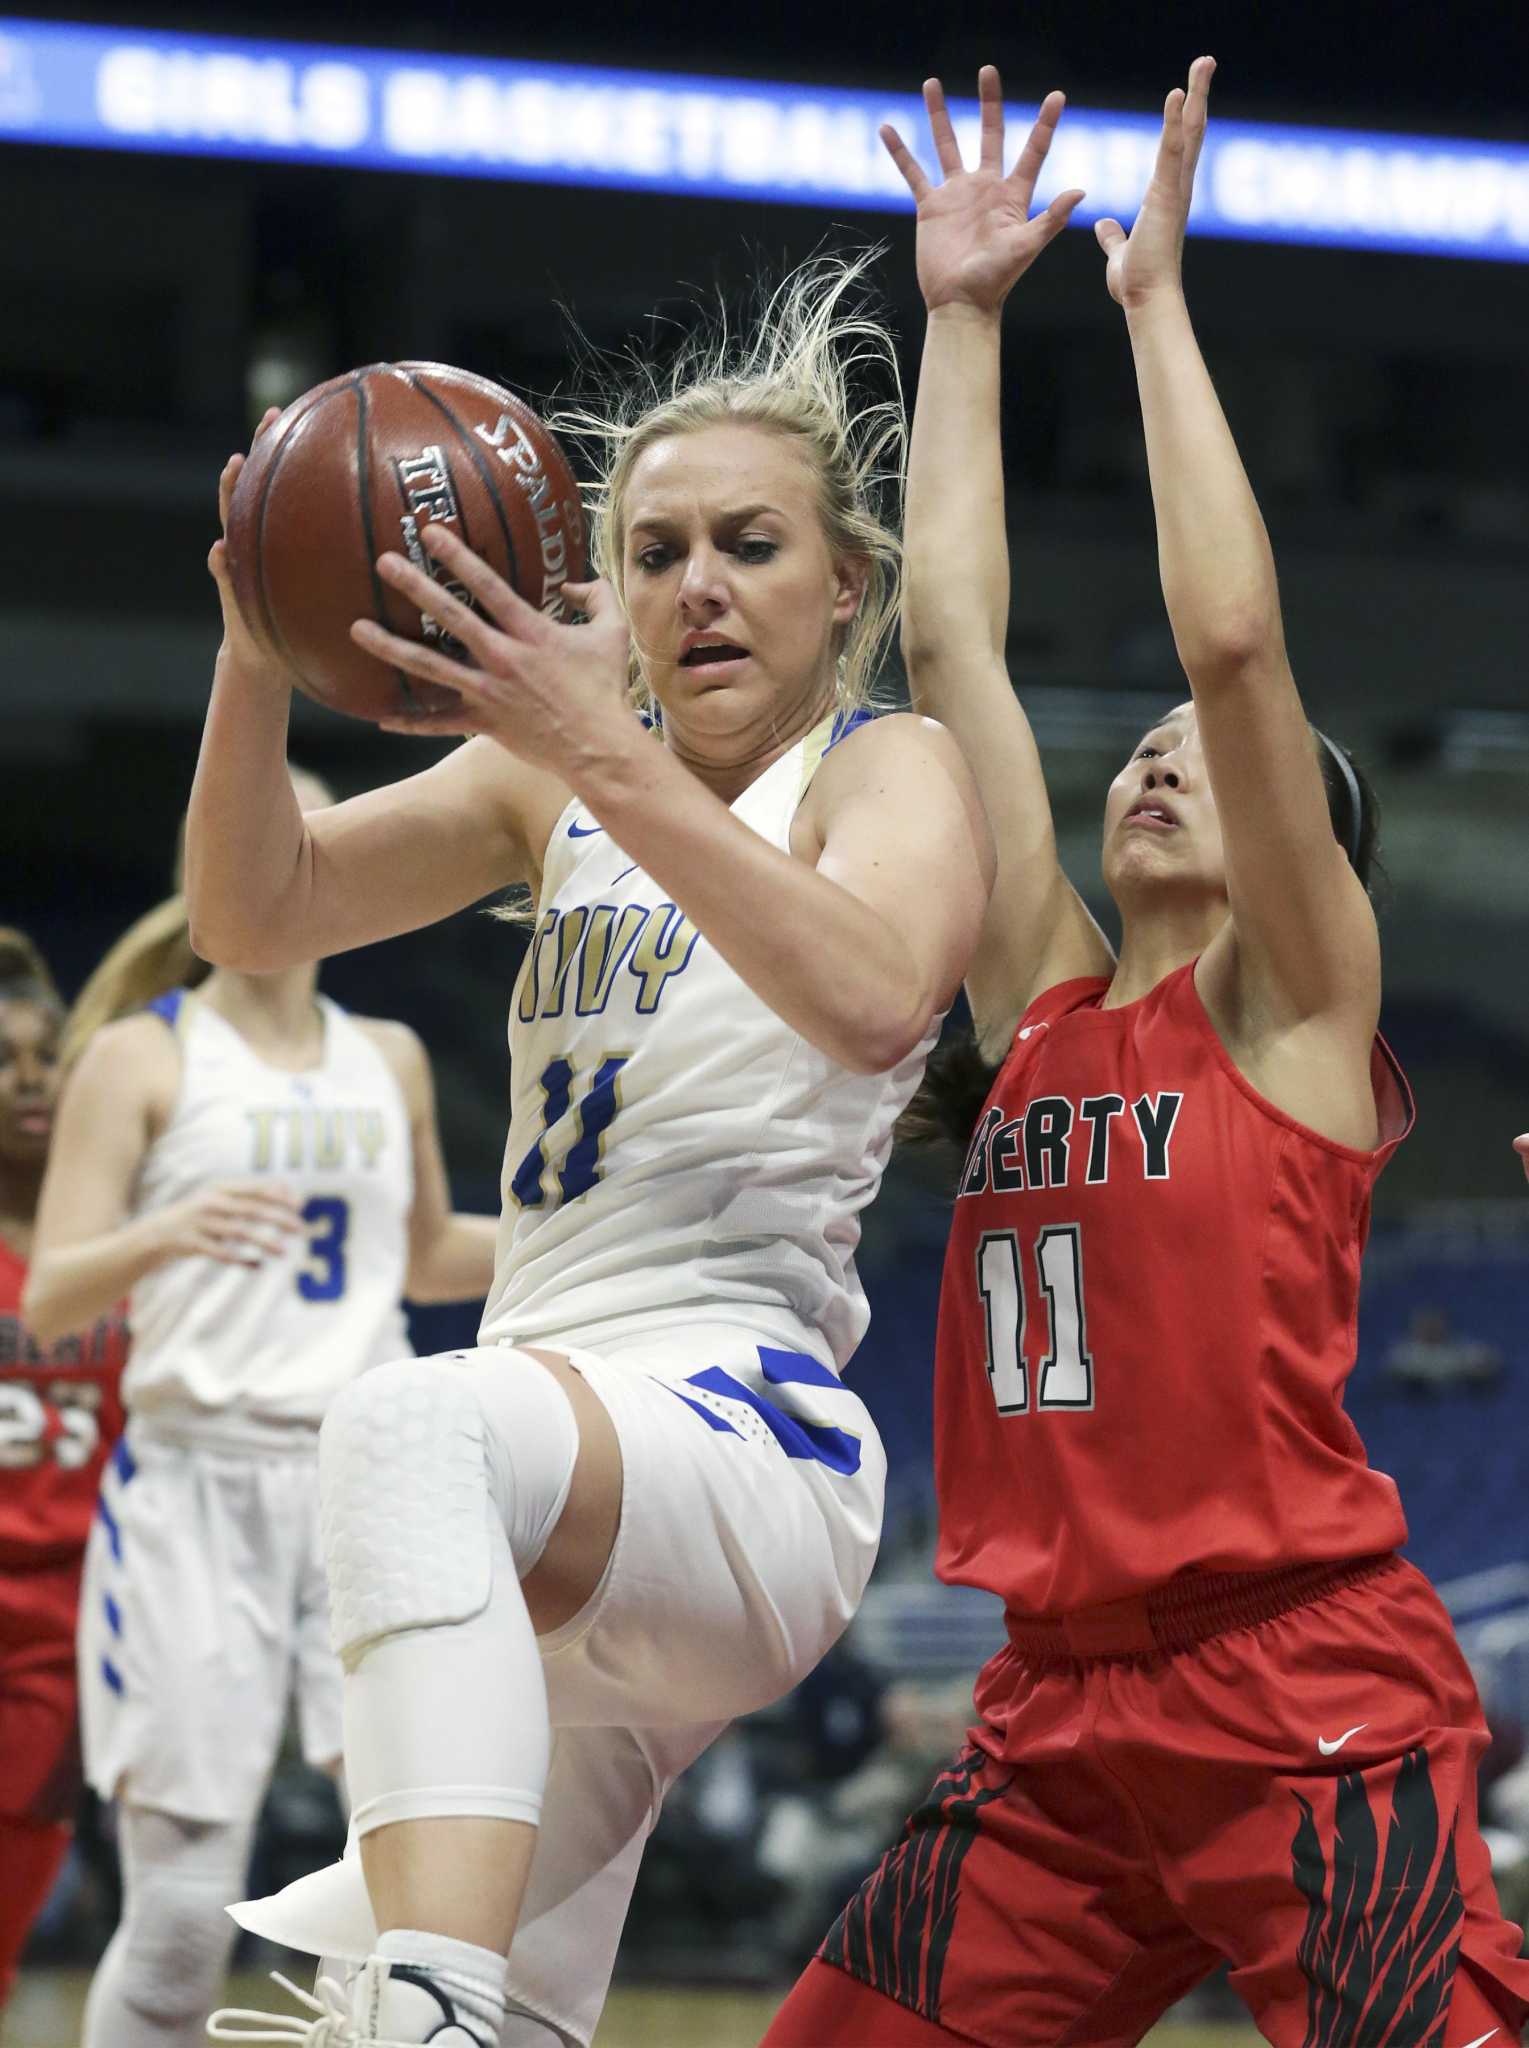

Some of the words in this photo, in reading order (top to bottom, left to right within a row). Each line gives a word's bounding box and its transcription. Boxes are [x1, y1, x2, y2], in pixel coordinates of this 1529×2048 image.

[473, 414, 568, 622] SPALDIN
[510, 1050, 634, 1211] 11
[956, 1091, 1184, 1199] BERTY
[295, 1192, 350, 1304] 3
[975, 1222, 1095, 1417] 11
